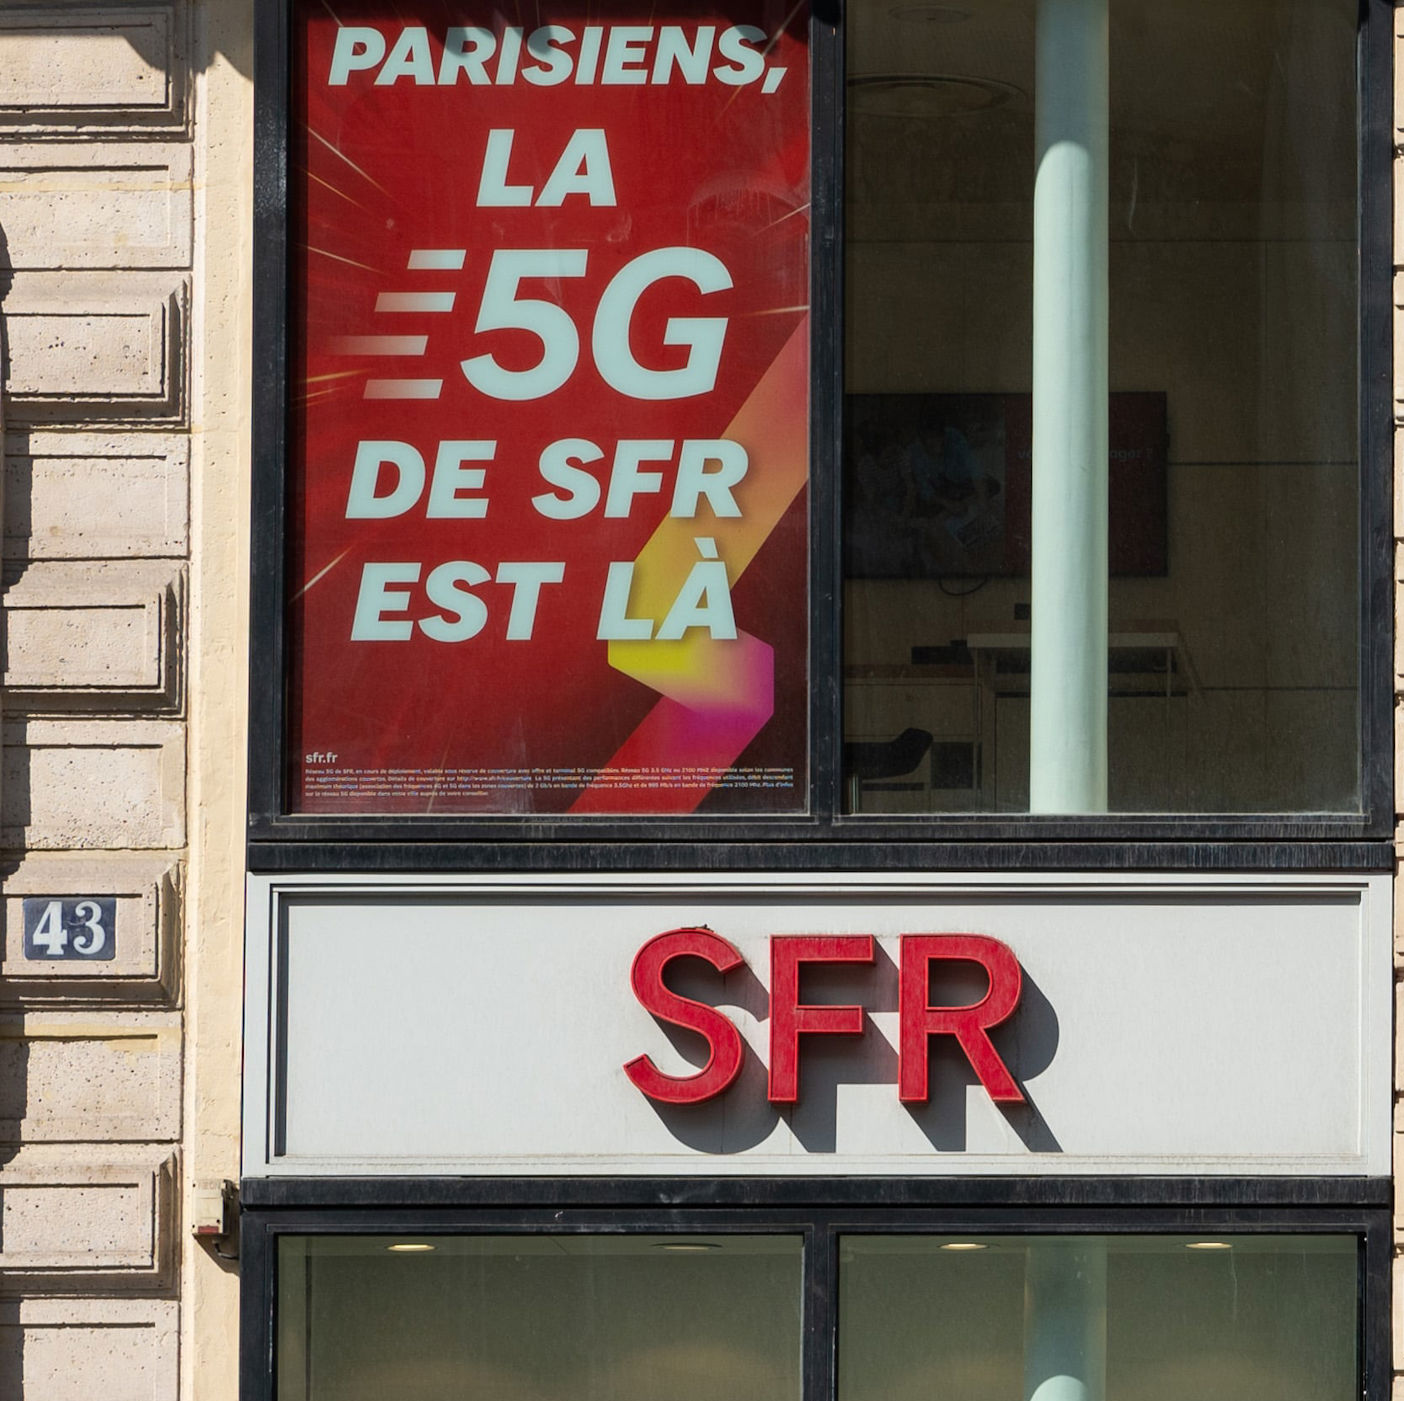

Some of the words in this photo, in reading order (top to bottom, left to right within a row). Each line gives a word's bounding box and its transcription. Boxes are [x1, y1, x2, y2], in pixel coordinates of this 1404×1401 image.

[329, 26, 789, 94] PARISIENS,
[476, 128, 617, 208] LA
[460, 246, 733, 401] 5G
[344, 440, 496, 520] DE
[532, 440, 748, 520] SFR
[351, 560, 565, 642] EST
[596, 537, 737, 642] LÀ
[305, 751, 338, 764] sfr.fr
[32, 900, 106, 956] 43
[623, 928, 1024, 1104] SFR
